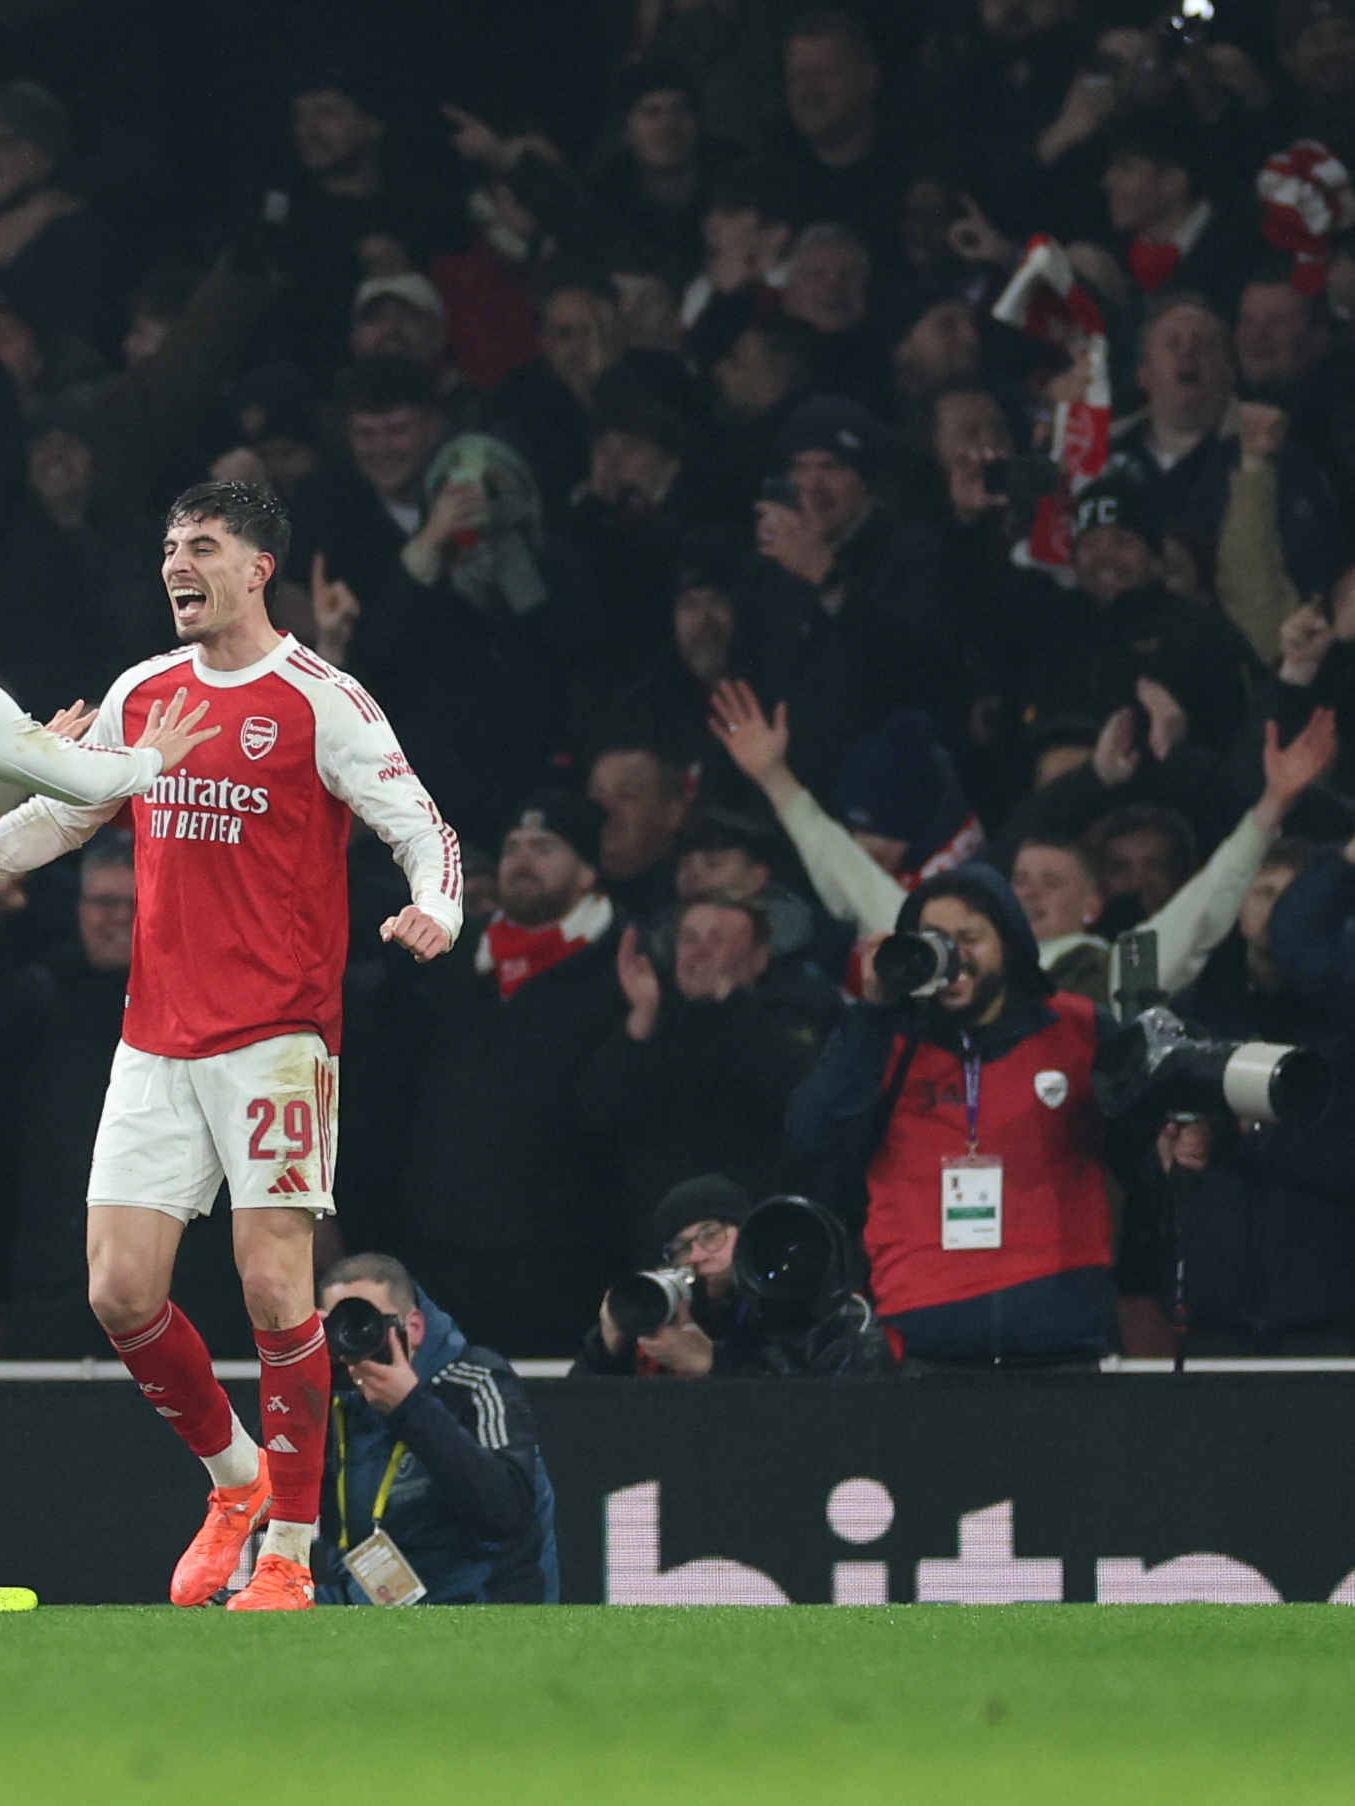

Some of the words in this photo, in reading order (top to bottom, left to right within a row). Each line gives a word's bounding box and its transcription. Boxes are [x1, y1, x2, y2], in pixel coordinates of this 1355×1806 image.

[150, 810, 173, 838] FLY
[175, 810, 243, 844] BETTER
[246, 1097, 313, 1160] 29
